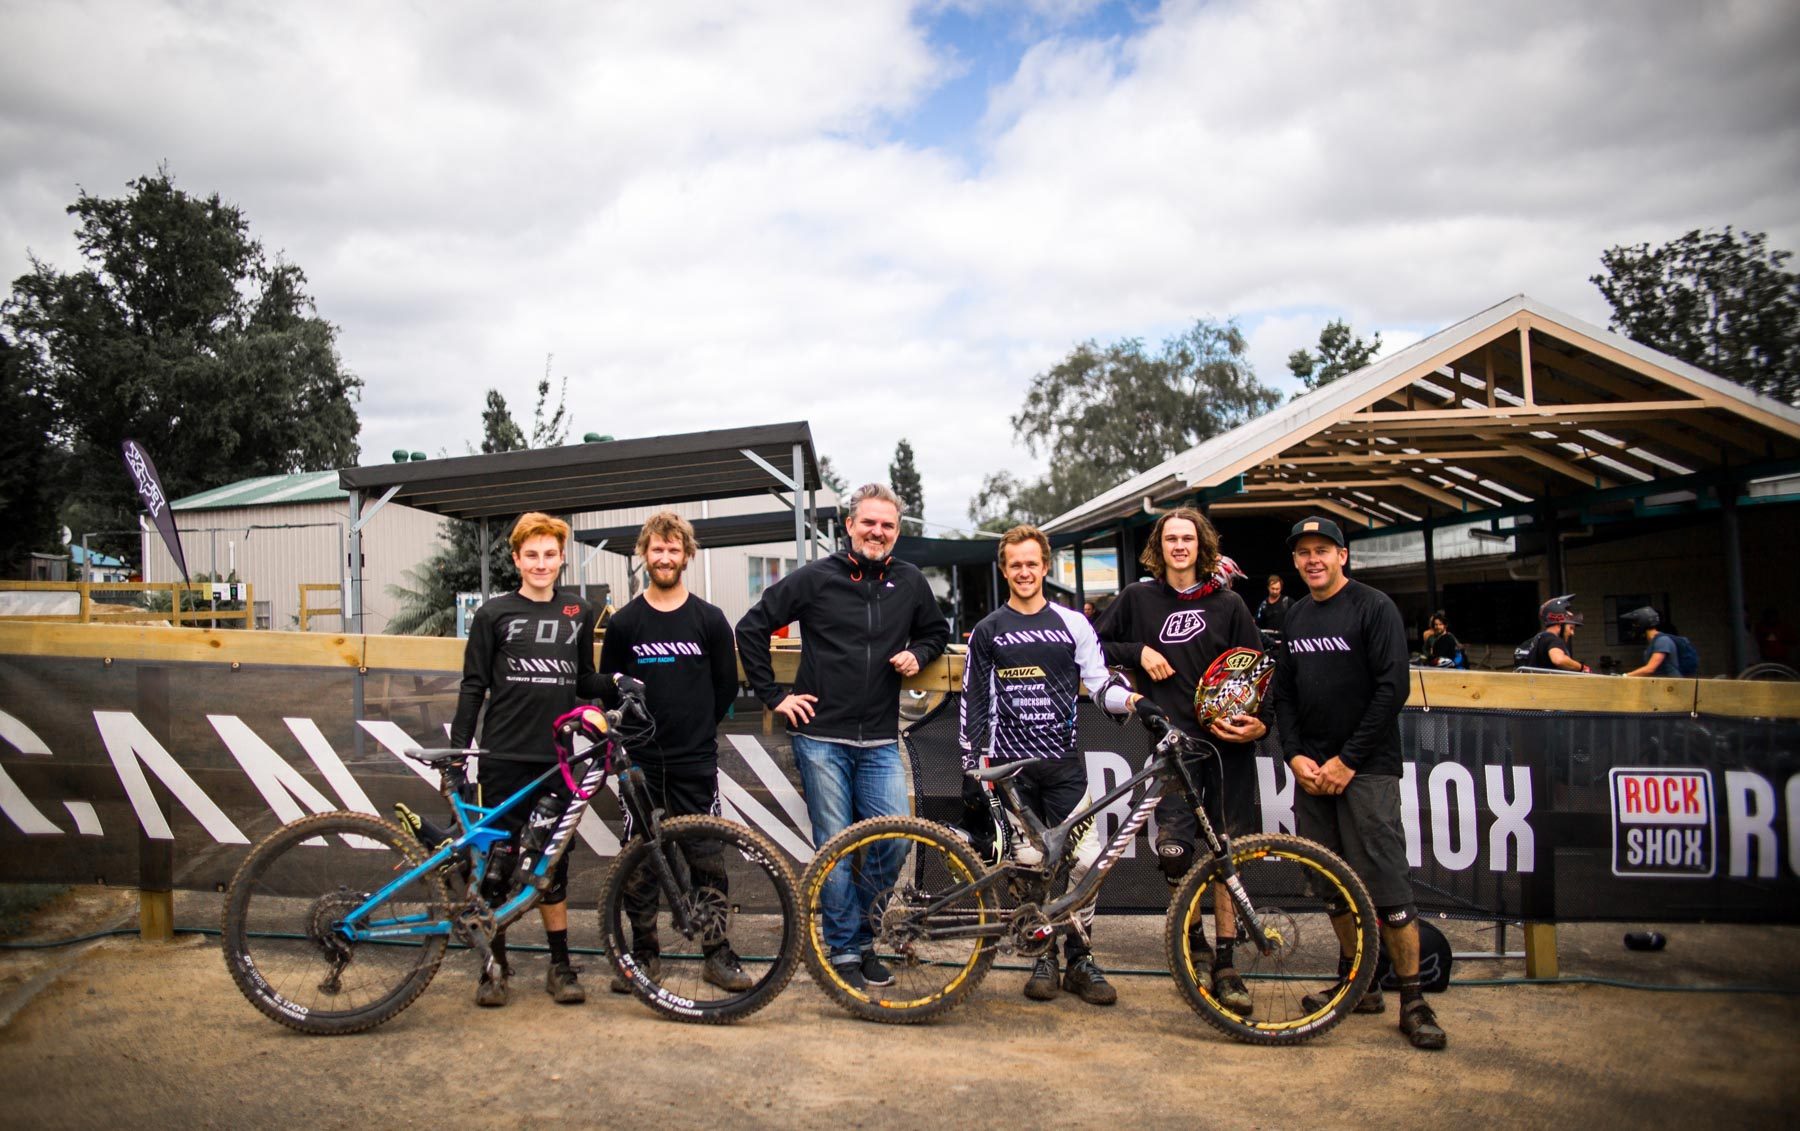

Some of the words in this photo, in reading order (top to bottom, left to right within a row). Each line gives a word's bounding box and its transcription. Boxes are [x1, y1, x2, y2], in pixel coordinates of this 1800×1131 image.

[506, 619, 583, 645] FOX
[994, 629, 1073, 646] CANYON
[632, 642, 702, 657] CANYON
[1288, 637, 1351, 654] CANYON
[1002, 668, 1038, 678] MAVIC
[1624, 777, 1700, 814] ROCK
[1097, 796, 1162, 870] CANYON
[1725, 771, 1800, 878] R
[1627, 828, 1702, 866] SHOX
[623, 953, 635, 967] DT
[631, 966, 651, 987] SWISS
[282, 999, 309, 1015] 1700
[668, 993, 695, 1009] 1700
